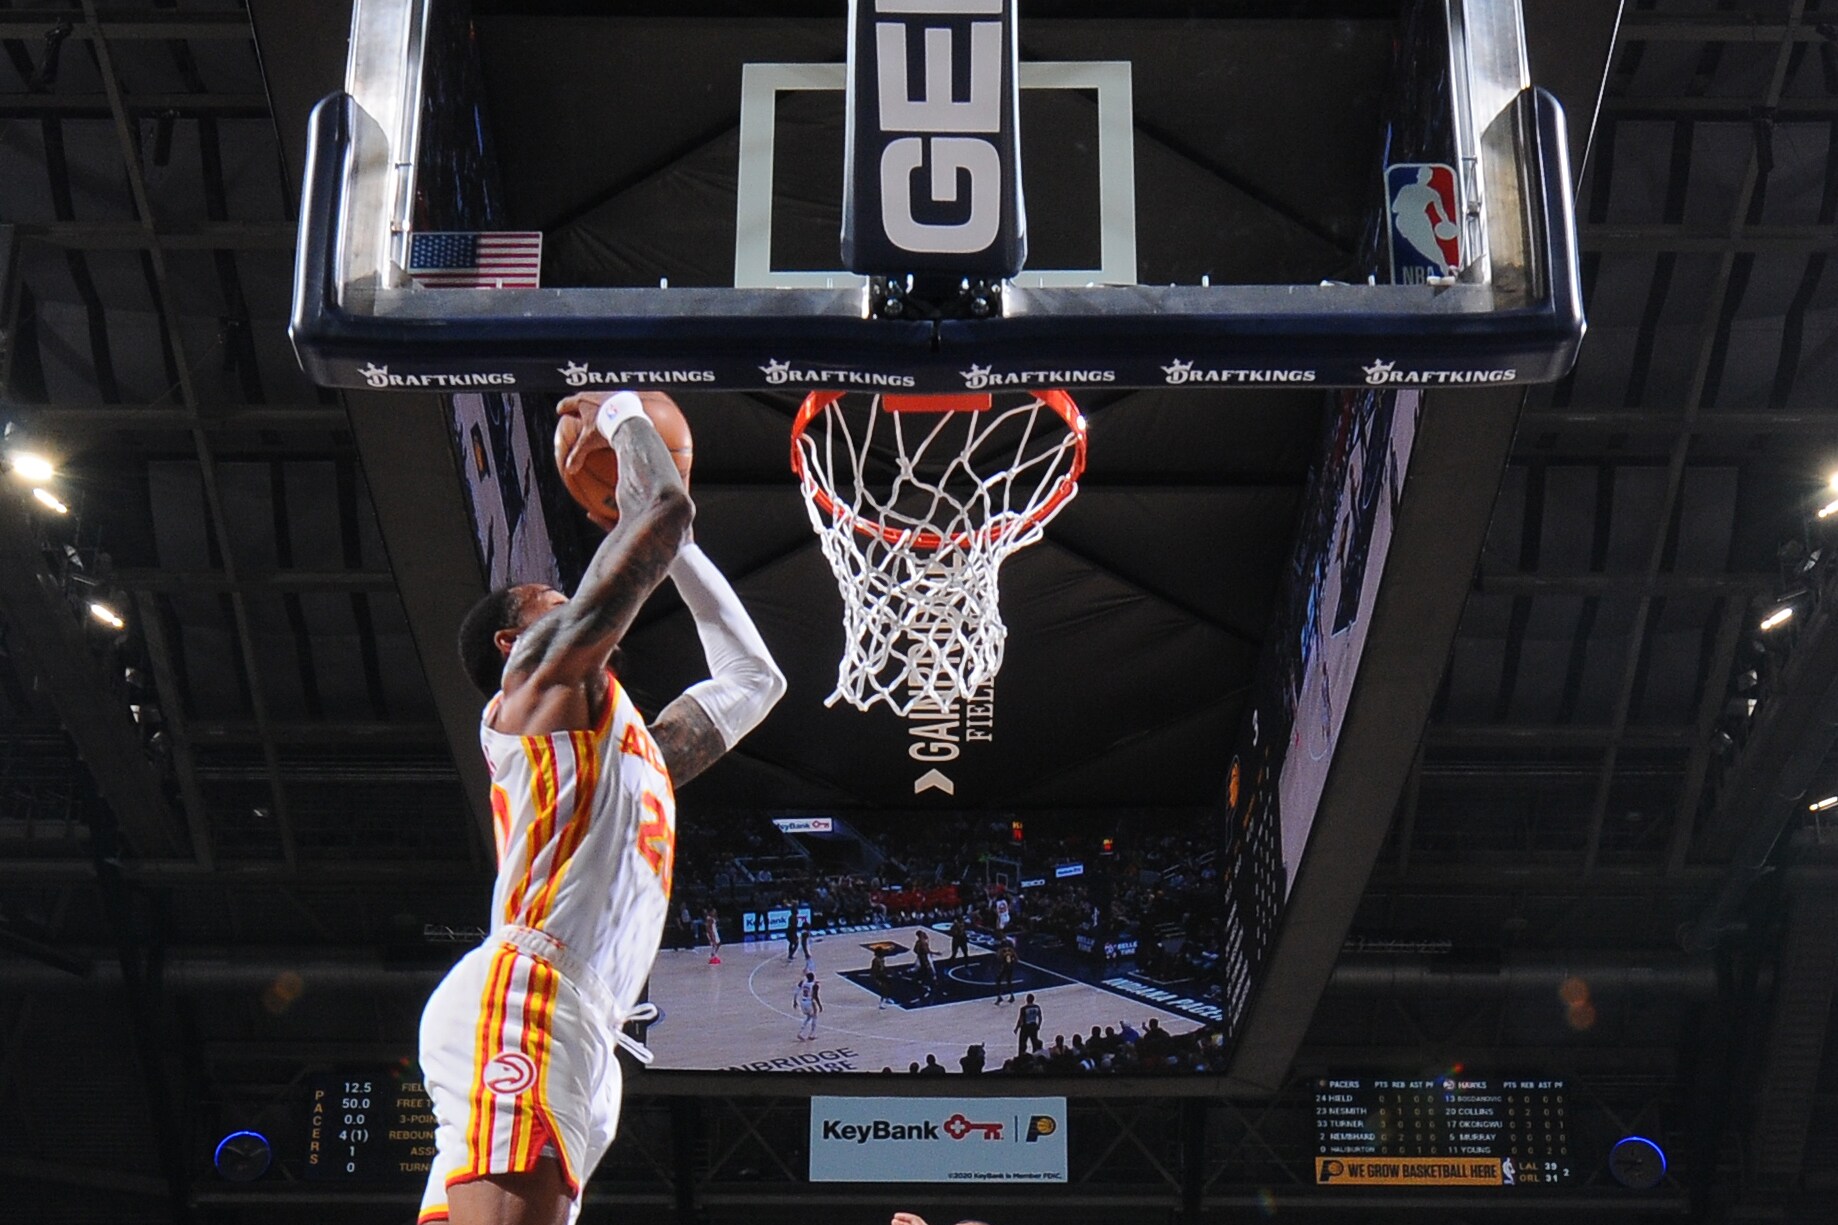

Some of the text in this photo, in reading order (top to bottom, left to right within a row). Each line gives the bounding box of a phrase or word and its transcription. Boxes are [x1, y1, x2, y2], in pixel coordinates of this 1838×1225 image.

[362, 368, 516, 388] DRAFTKINGS
[564, 368, 716, 387] DRAFTKINGS
[765, 367, 916, 388] DRAFTKINGS
[966, 368, 1116, 389] DRAFTKINGS
[1166, 367, 1317, 386] DRAFTKINGS
[1365, 366, 1517, 387] DRAFTKINGS
[344, 1082, 425, 1093] 12.5 FIEL
[1329, 1081, 1360, 1089] PACERS
[1374, 1081, 1388, 1089] PTS
[1392, 1081, 1406, 1089] REB
[1409, 1081, 1423, 1089] AST
[341, 1098, 423, 1109] 50.0 FREE
[344, 1114, 438, 1125] 0.0 3-POIN
[308, 1090, 324, 1164] PACERS
[823, 1120, 940, 1144] KeyBank
[339, 1129, 434, 1143] 4 (1) REBOUN
[349, 1145, 436, 1157] 1 ASSI
[346, 1162, 429, 1173] 0 TURN
[1348, 1164, 1497, 1179] WE GROW BASKETBALL HERE
[1518, 1162, 1538, 1170] LAL
[1519, 1174, 1540, 1182] ORL
